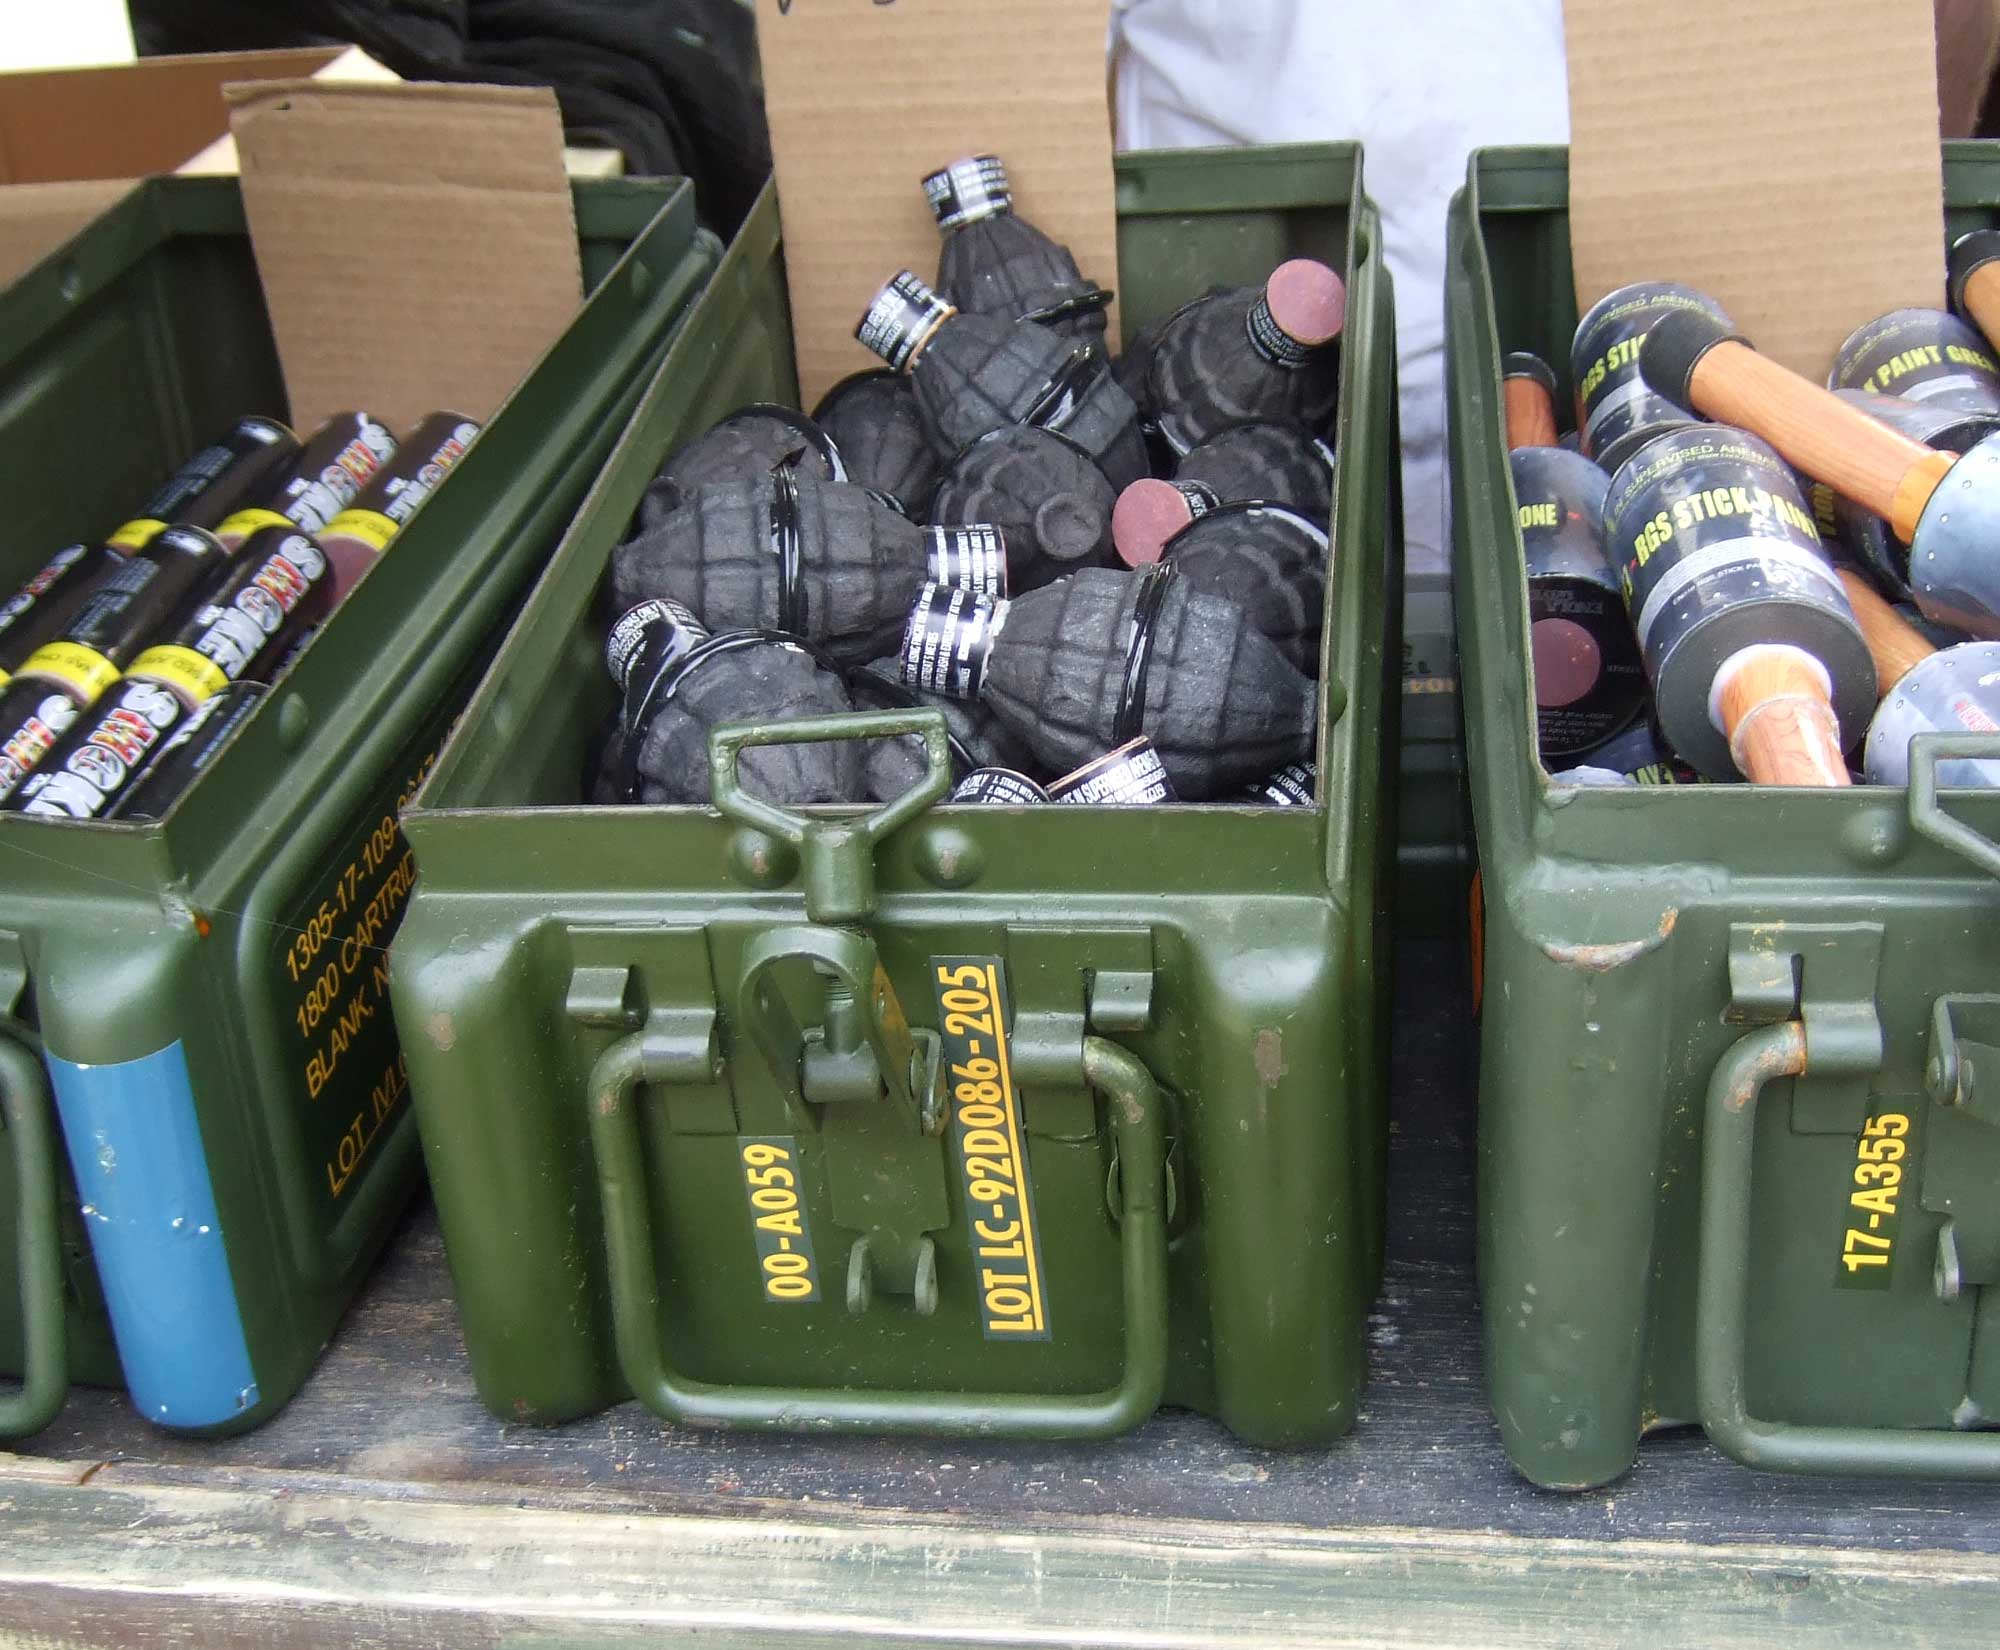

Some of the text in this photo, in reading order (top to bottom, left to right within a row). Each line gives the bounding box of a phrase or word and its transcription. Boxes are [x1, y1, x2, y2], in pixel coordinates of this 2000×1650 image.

[1877, 345, 1942, 387] PAINT
[1519, 503, 1558, 529] ONE
[1624, 445, 1714, 498] SUPERVISED
[1673, 486, 1752, 530] STICK
[297, 849, 417, 1038] 1800 CARTRID
[306, 985, 375, 1099] BLANK,
[327, 1112, 364, 1194] LOT
[938, 964, 1034, 1331] LOT LC-92D086-205
[1842, 1113, 1910, 1272] 17-A355
[743, 1143, 813, 1298] 00-A059
